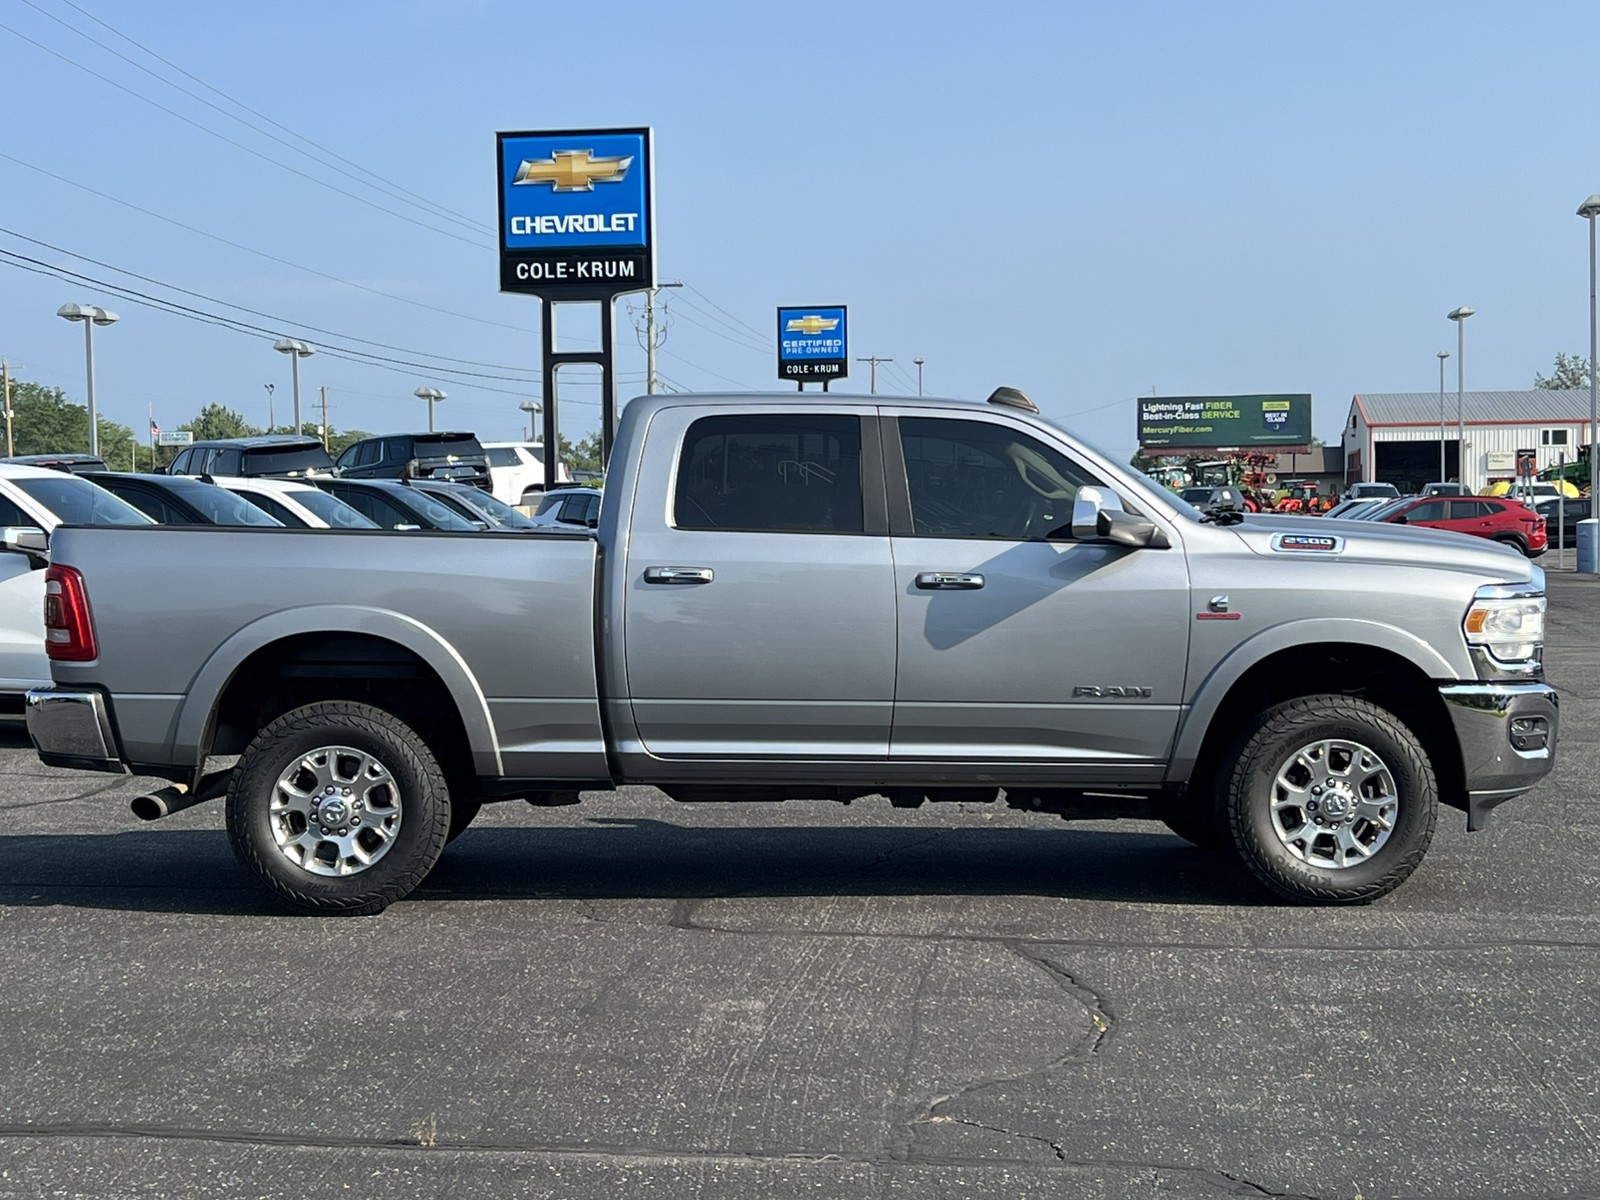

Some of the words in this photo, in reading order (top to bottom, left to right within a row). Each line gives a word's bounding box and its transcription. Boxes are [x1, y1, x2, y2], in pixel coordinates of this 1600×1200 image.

[511, 213, 638, 235] CHEVROLET
[516, 260, 635, 280] COLE-KRUM
[783, 339, 842, 348] CERTIFIED
[786, 346, 839, 354] PRE-OWNED
[786, 364, 839, 374] COLE-KRUM
[1142, 403, 1183, 413] Lightning
[1205, 402, 1232, 410] FIBER
[1142, 411, 1200, 421] Best-in-Class
[1201, 410, 1240, 419] SERVICE
[1142, 426, 1212, 435] MercuryFiber.com
[1284, 537, 1332, 545] 2500
[1072, 685, 1153, 698] RAM
